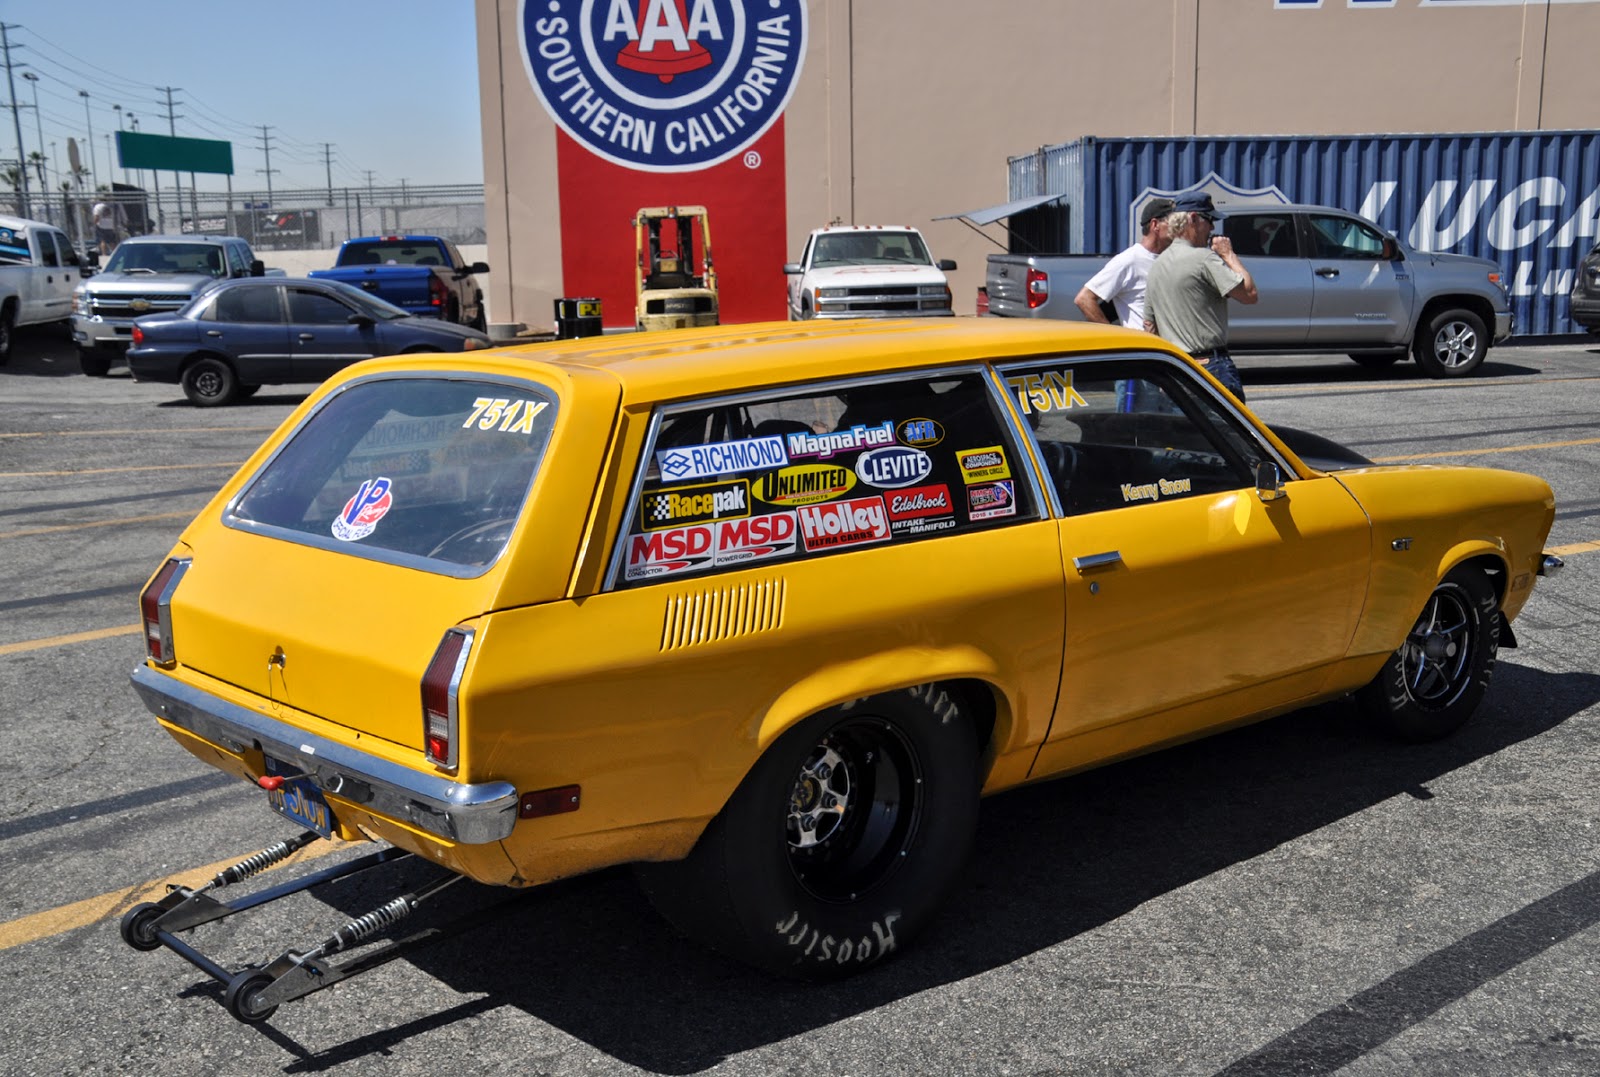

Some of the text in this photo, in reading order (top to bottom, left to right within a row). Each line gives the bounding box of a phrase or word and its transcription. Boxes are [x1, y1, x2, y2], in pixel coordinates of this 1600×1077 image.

[603, 0, 723, 52] AAA
[536, 14, 790, 154] SOUTHERN CALIFORNIA
[1007, 369, 1089, 415] 751X
[463, 397, 549, 434] 751X
[906, 420, 936, 442] AFR
[790, 423, 894, 456] MagnaFuel
[692, 440, 783, 474] RICHMOND
[858, 451, 927, 483] CLEVITE
[763, 467, 847, 501] UNLIMITED
[792, 494, 828, 504] PRODUCTS
[1120, 478, 1191, 501] Kenny Snow
[346, 479, 390, 525] VP
[669, 486, 746, 519] Racepak
[891, 492, 947, 514] Edelbrock
[719, 513, 794, 551] MSD
[800, 503, 887, 538] Holley
[892, 518, 924, 529] INTAKE
[909, 520, 956, 534] MANIFOLD
[630, 527, 711, 565] MSD
[808, 531, 874, 548] ULTRA CARBS
[1391, 537, 1413, 551] GT
[627, 567, 663, 578] CONDUCTOR
